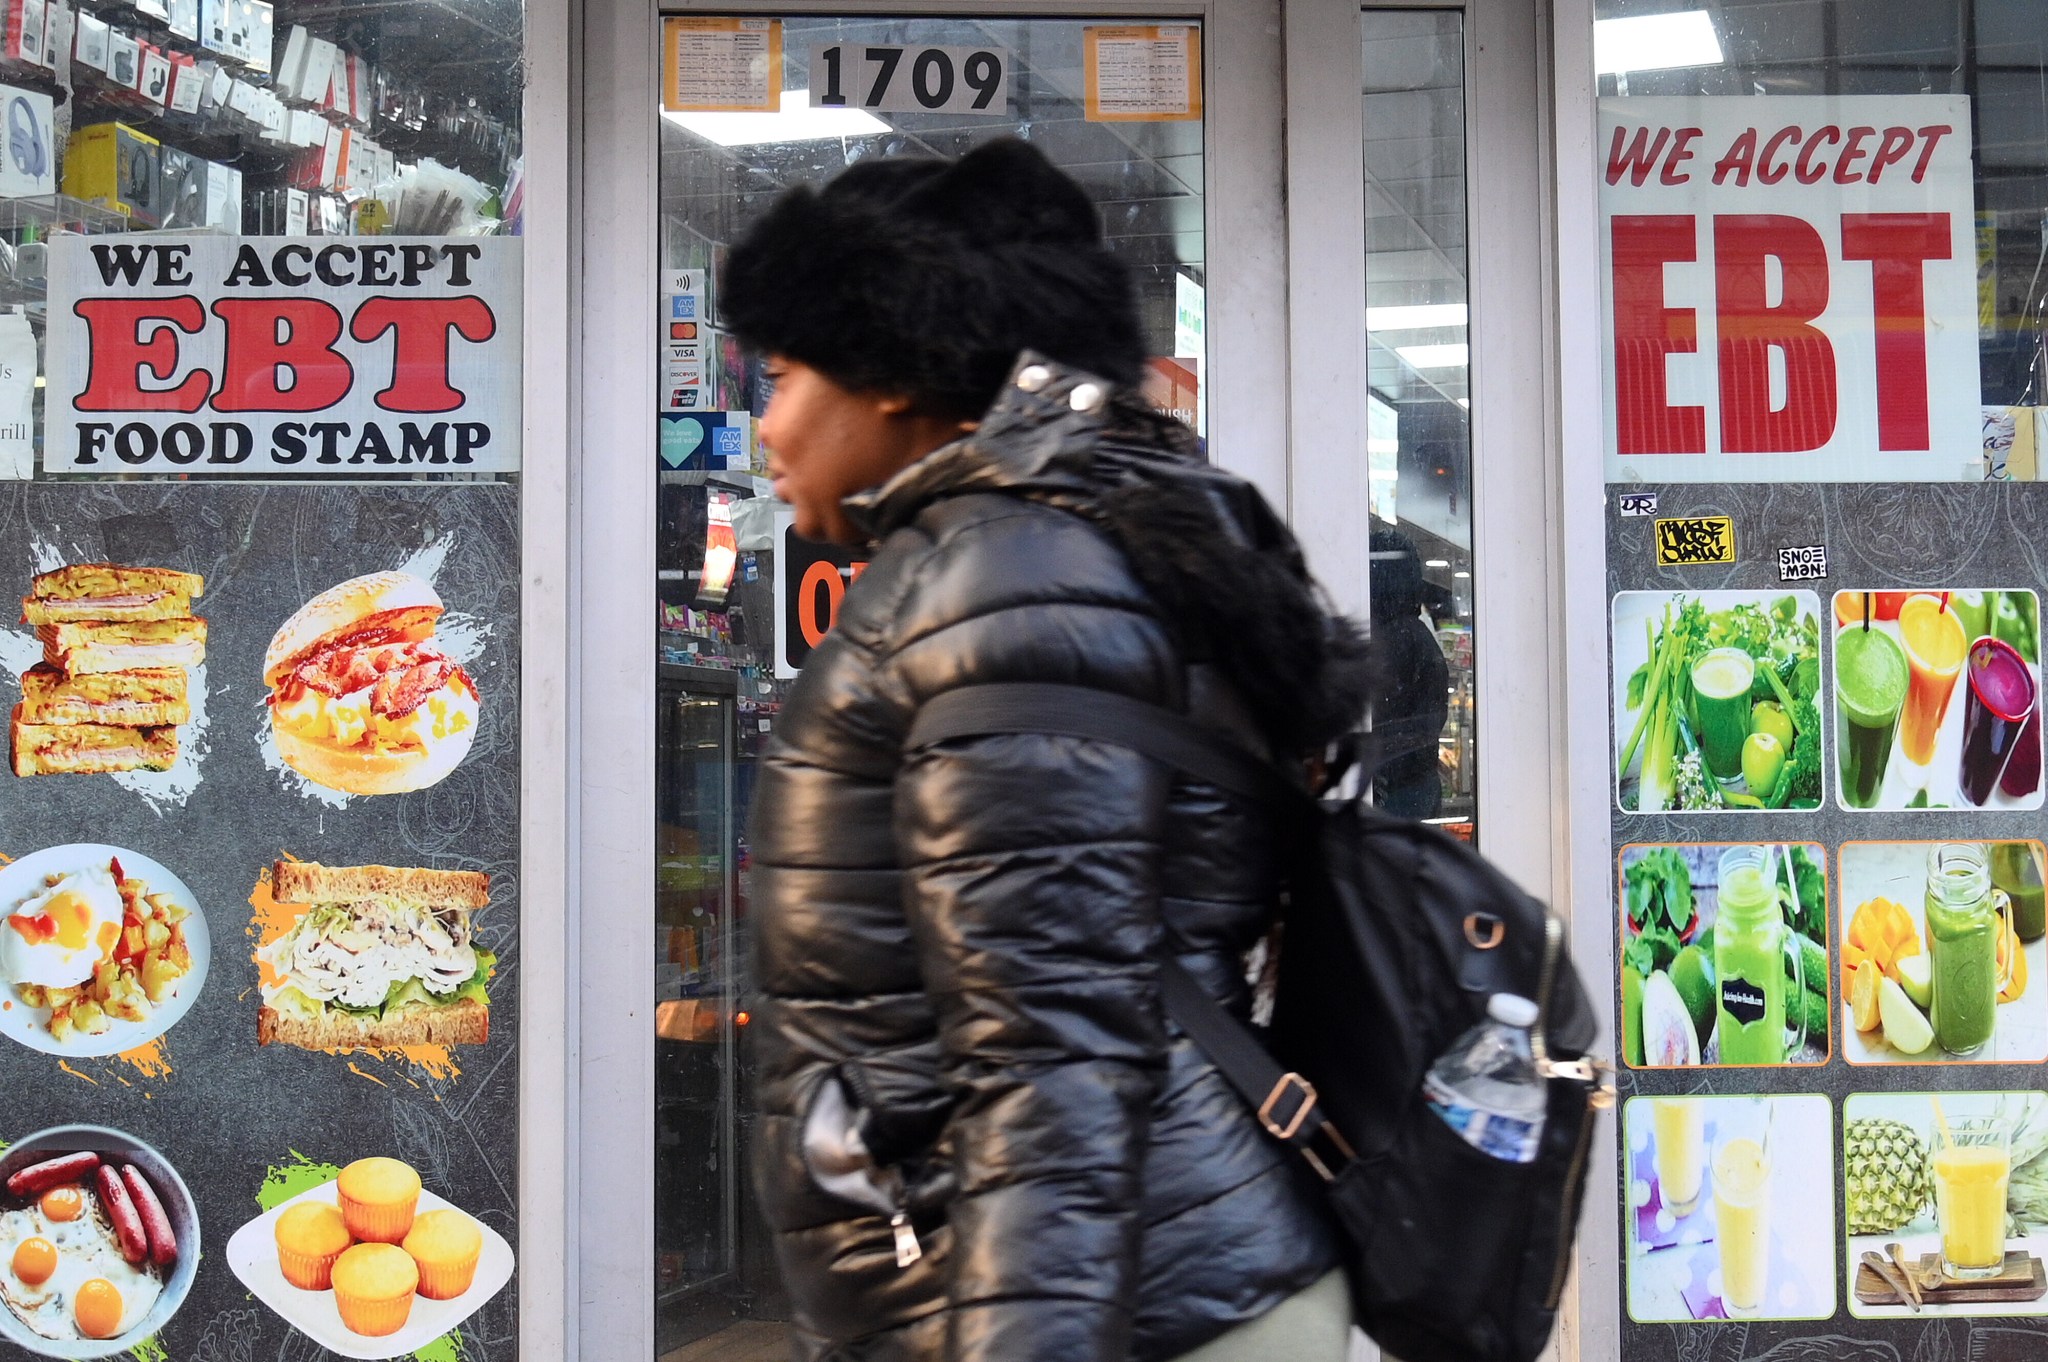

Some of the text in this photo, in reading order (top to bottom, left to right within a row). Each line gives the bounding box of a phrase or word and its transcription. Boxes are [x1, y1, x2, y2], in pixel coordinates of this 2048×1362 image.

[820, 46, 1002, 110] 1709
[1605, 124, 1952, 188] WE ACCEPT
[90, 244, 481, 287] WE ACCEPT
[72, 295, 496, 414] EBT
[674, 349, 695, 357] VISA
[1611, 212, 1952, 455] EBT
[74, 422, 491, 465] FOOD STAMP
